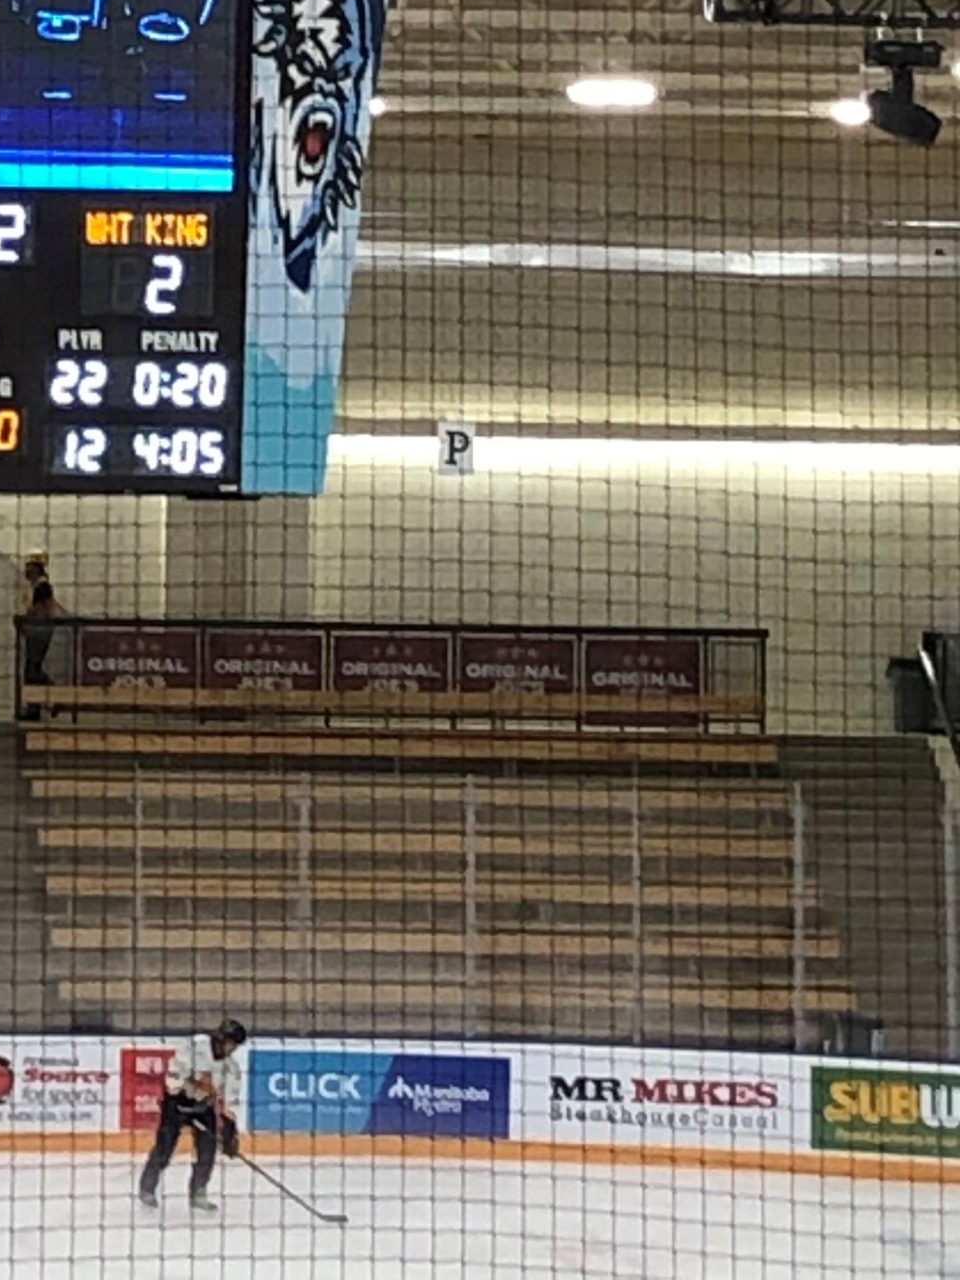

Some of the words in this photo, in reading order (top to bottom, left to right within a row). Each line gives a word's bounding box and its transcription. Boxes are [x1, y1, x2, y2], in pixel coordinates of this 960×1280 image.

[145, 213, 208, 246] KING
[144, 254, 183, 315] 2
[57, 329, 103, 351] PLYR
[141, 330, 219, 352] PENALTY
[50, 359, 108, 405] 22
[132, 361, 228, 408] 0:20
[64, 428, 107, 473] 12
[133, 428, 224, 475] 4:05
[444, 429, 470, 467] P
[88, 658, 187, 671] ORIGINAL
[214, 660, 316, 675] ORIGINAL
[342, 662, 440, 677] ORIGINAL
[465, 663, 567, 680] ORIGINAL
[592, 671, 691, 687] ORIGINAL
[23, 1068, 109, 1083] Source
[268, 1072, 361, 1099] CLICK
[550, 1075, 623, 1102] MR
[631, 1078, 778, 1108] MIKES
